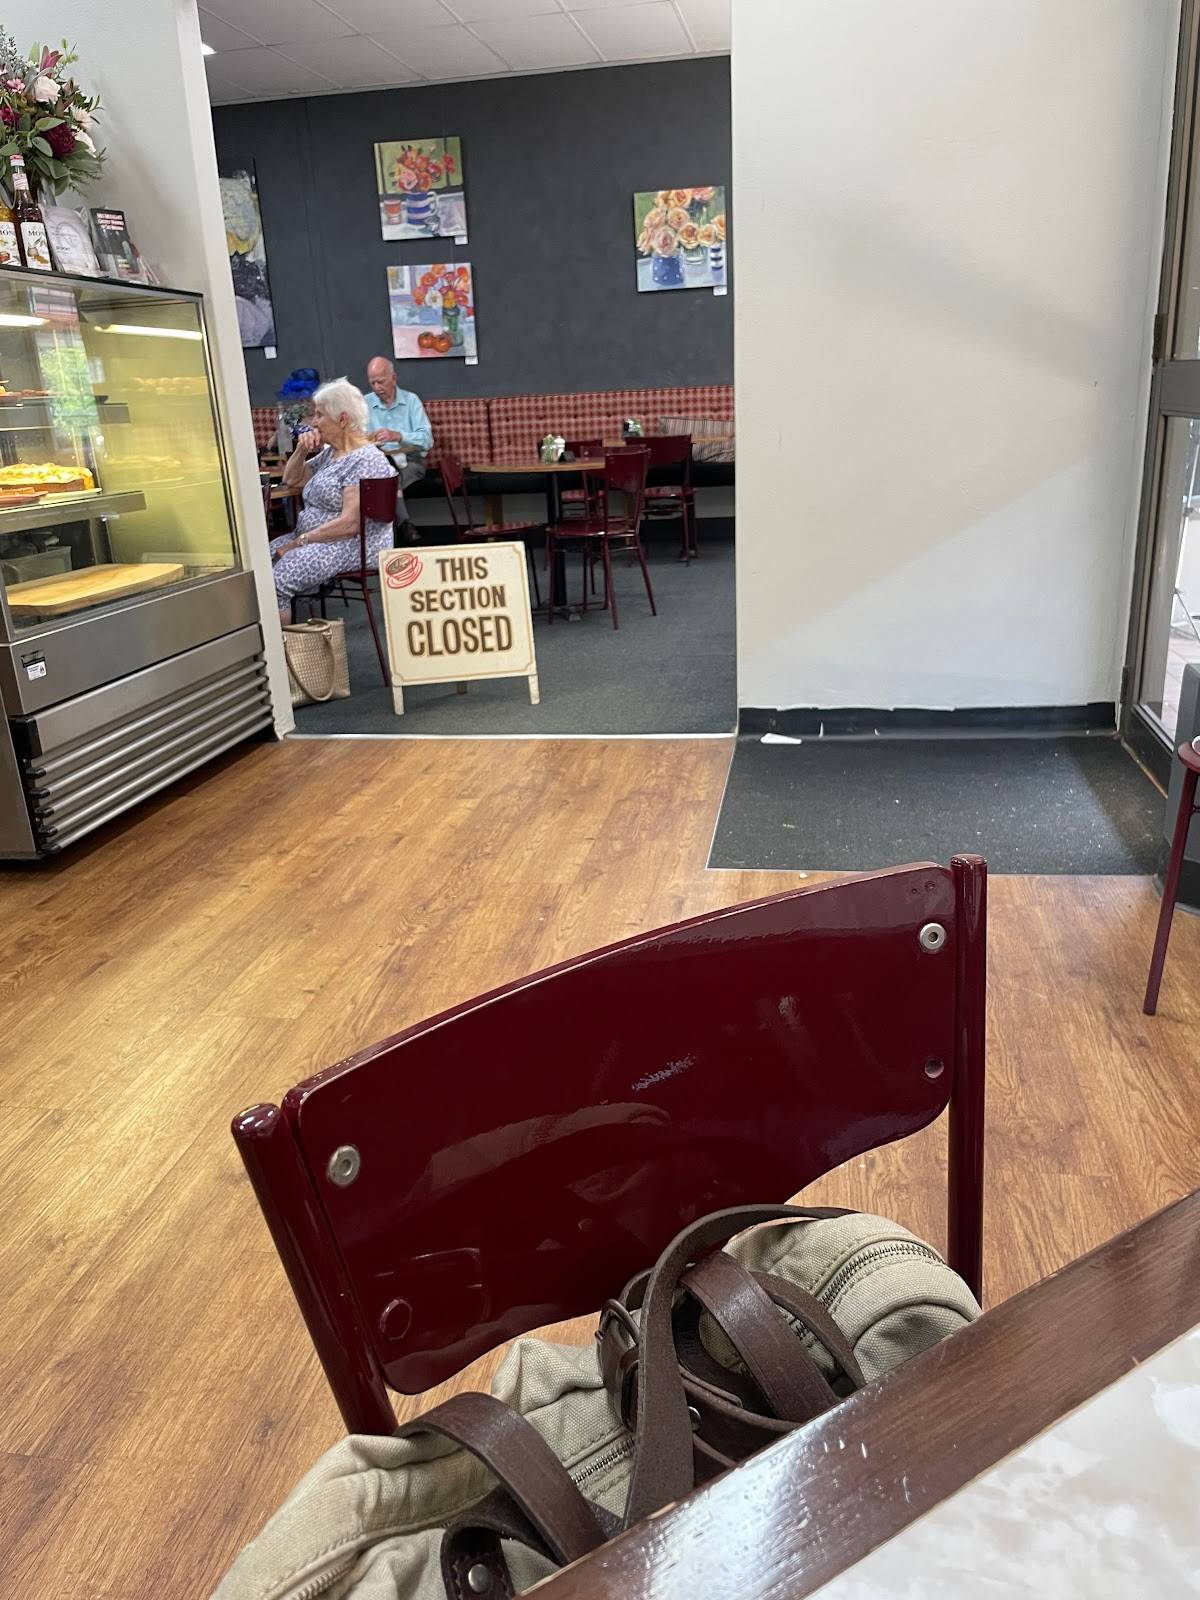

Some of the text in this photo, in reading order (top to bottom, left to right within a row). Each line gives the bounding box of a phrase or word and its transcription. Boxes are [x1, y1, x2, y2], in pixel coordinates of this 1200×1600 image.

[436, 557, 489, 582] THIS
[410, 586, 506, 612] SECTION
[407, 615, 513, 656] CLOSED
